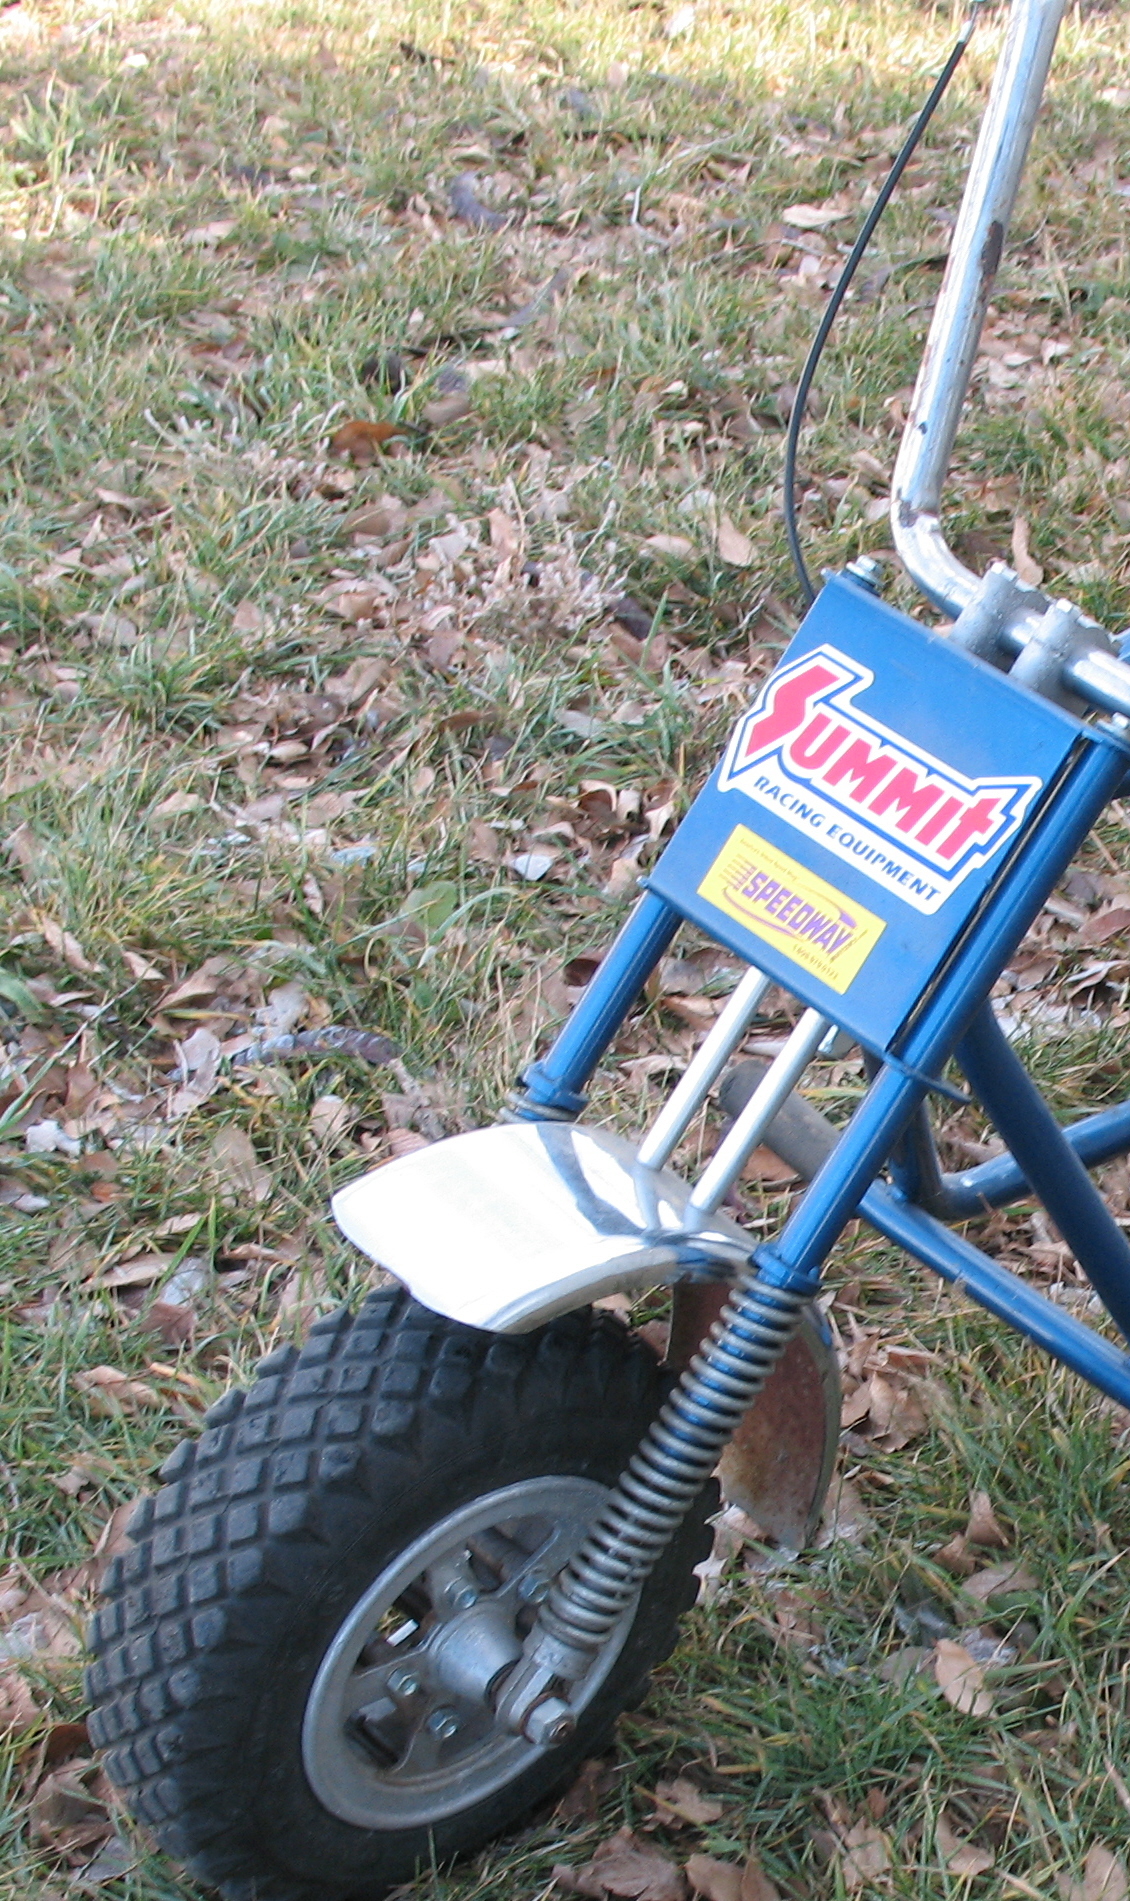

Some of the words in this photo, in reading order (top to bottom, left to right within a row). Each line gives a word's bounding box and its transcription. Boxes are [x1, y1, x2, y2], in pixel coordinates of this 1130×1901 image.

[753, 775, 826, 828] RACING
[825, 823, 942, 901] EQUIPMENT
[740, 870, 854, 955] SPEEDWAY
